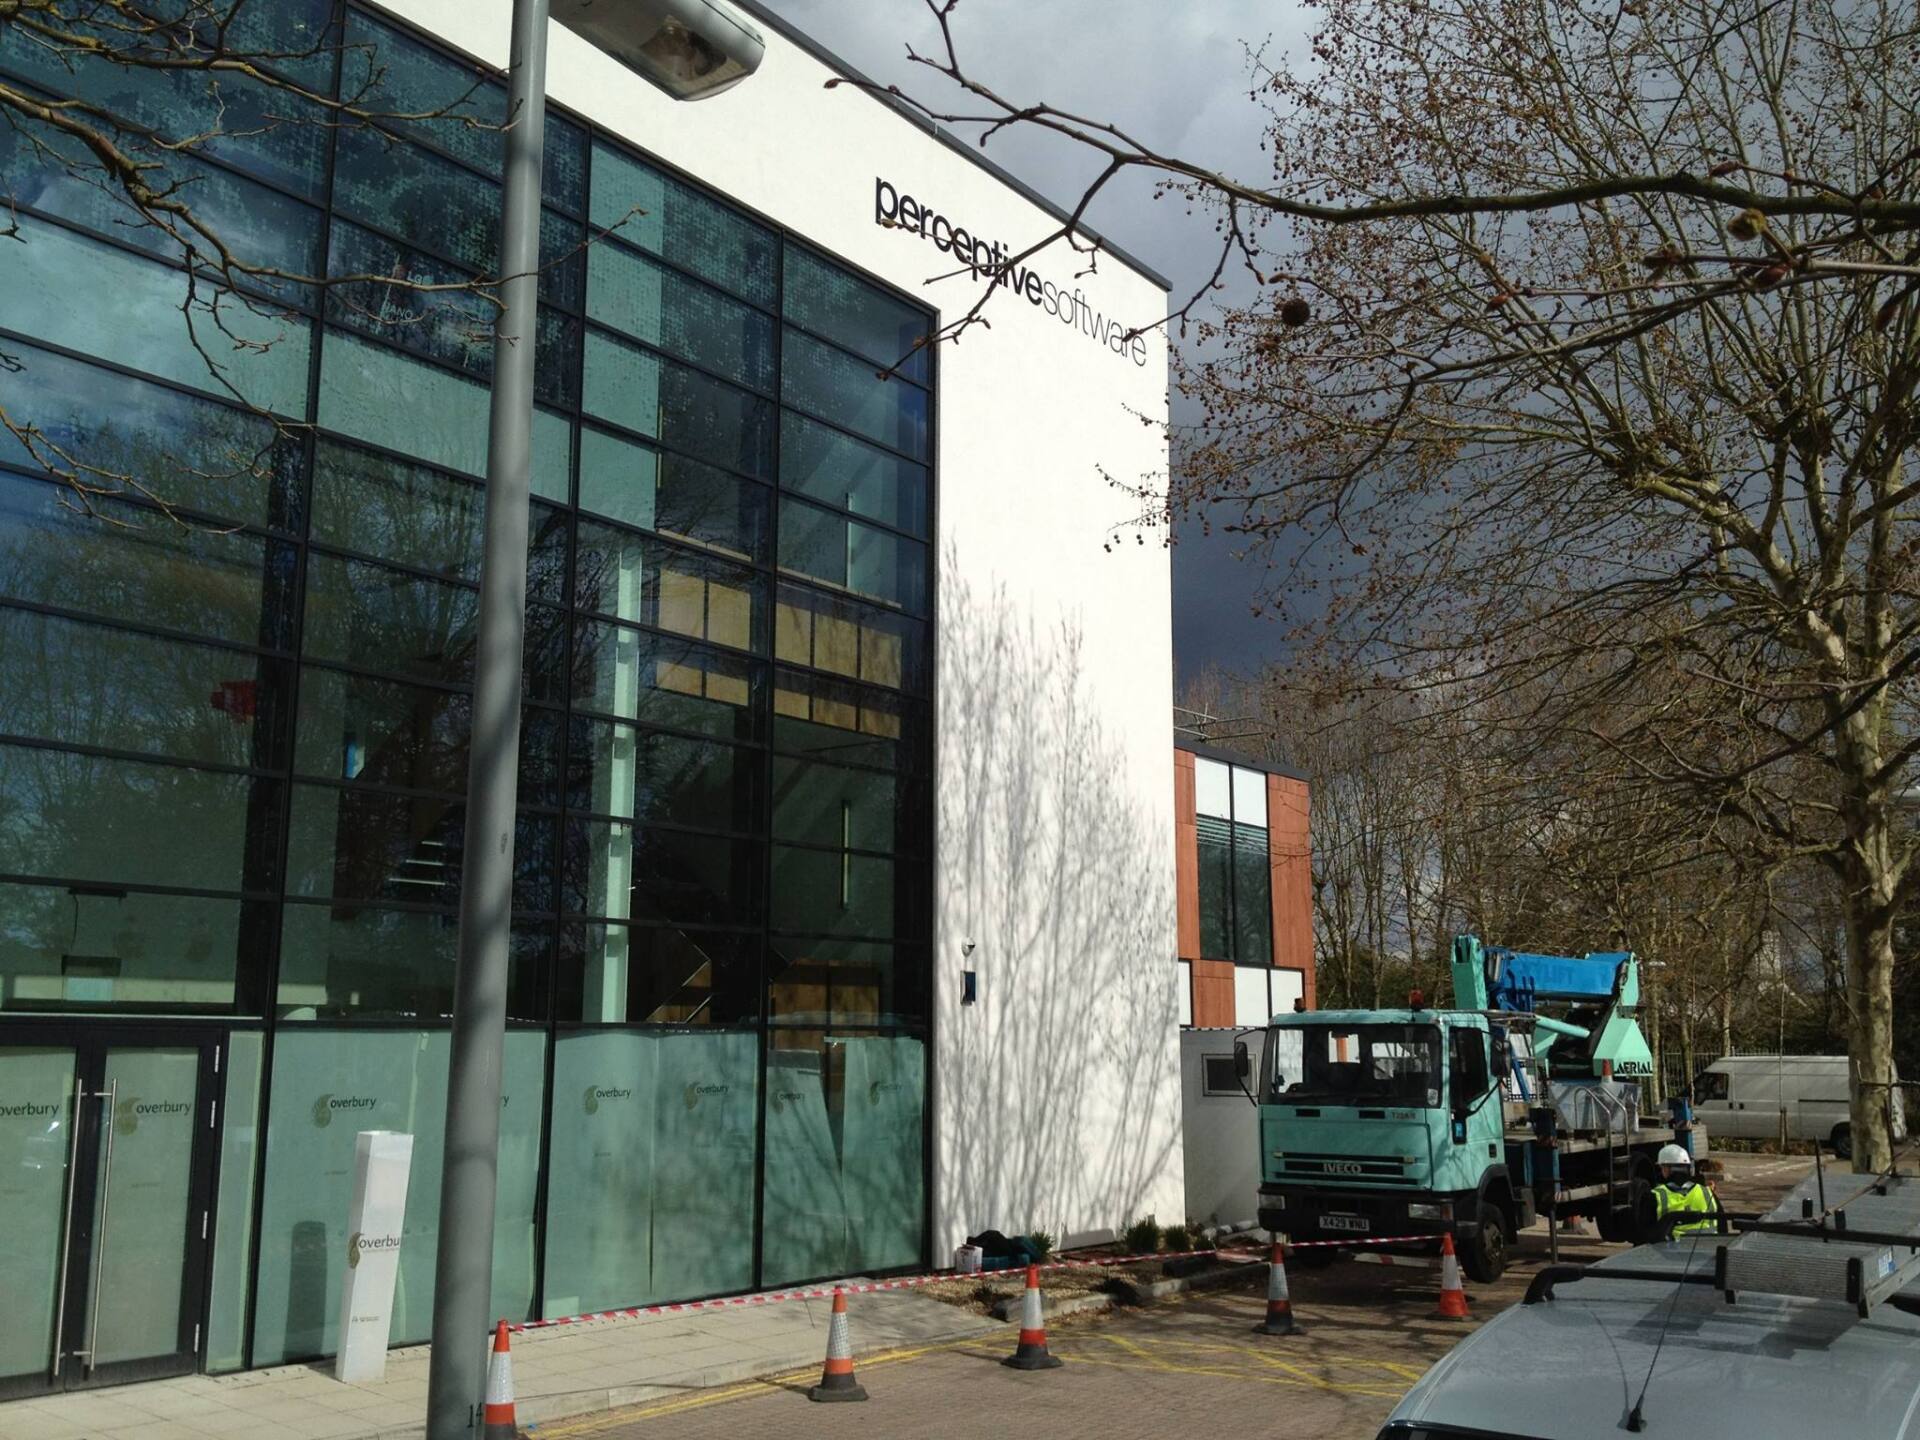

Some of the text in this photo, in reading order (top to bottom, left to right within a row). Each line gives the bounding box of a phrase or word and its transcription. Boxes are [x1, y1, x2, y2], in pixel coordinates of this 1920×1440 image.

[1615, 1061, 1654, 1075] AERIAL
[596, 1086, 631, 1099] overbury
[136, 1099, 192, 1116] overbury
[330, 1096, 377, 1110] overbury
[1323, 1162, 1362, 1175] IVECO
